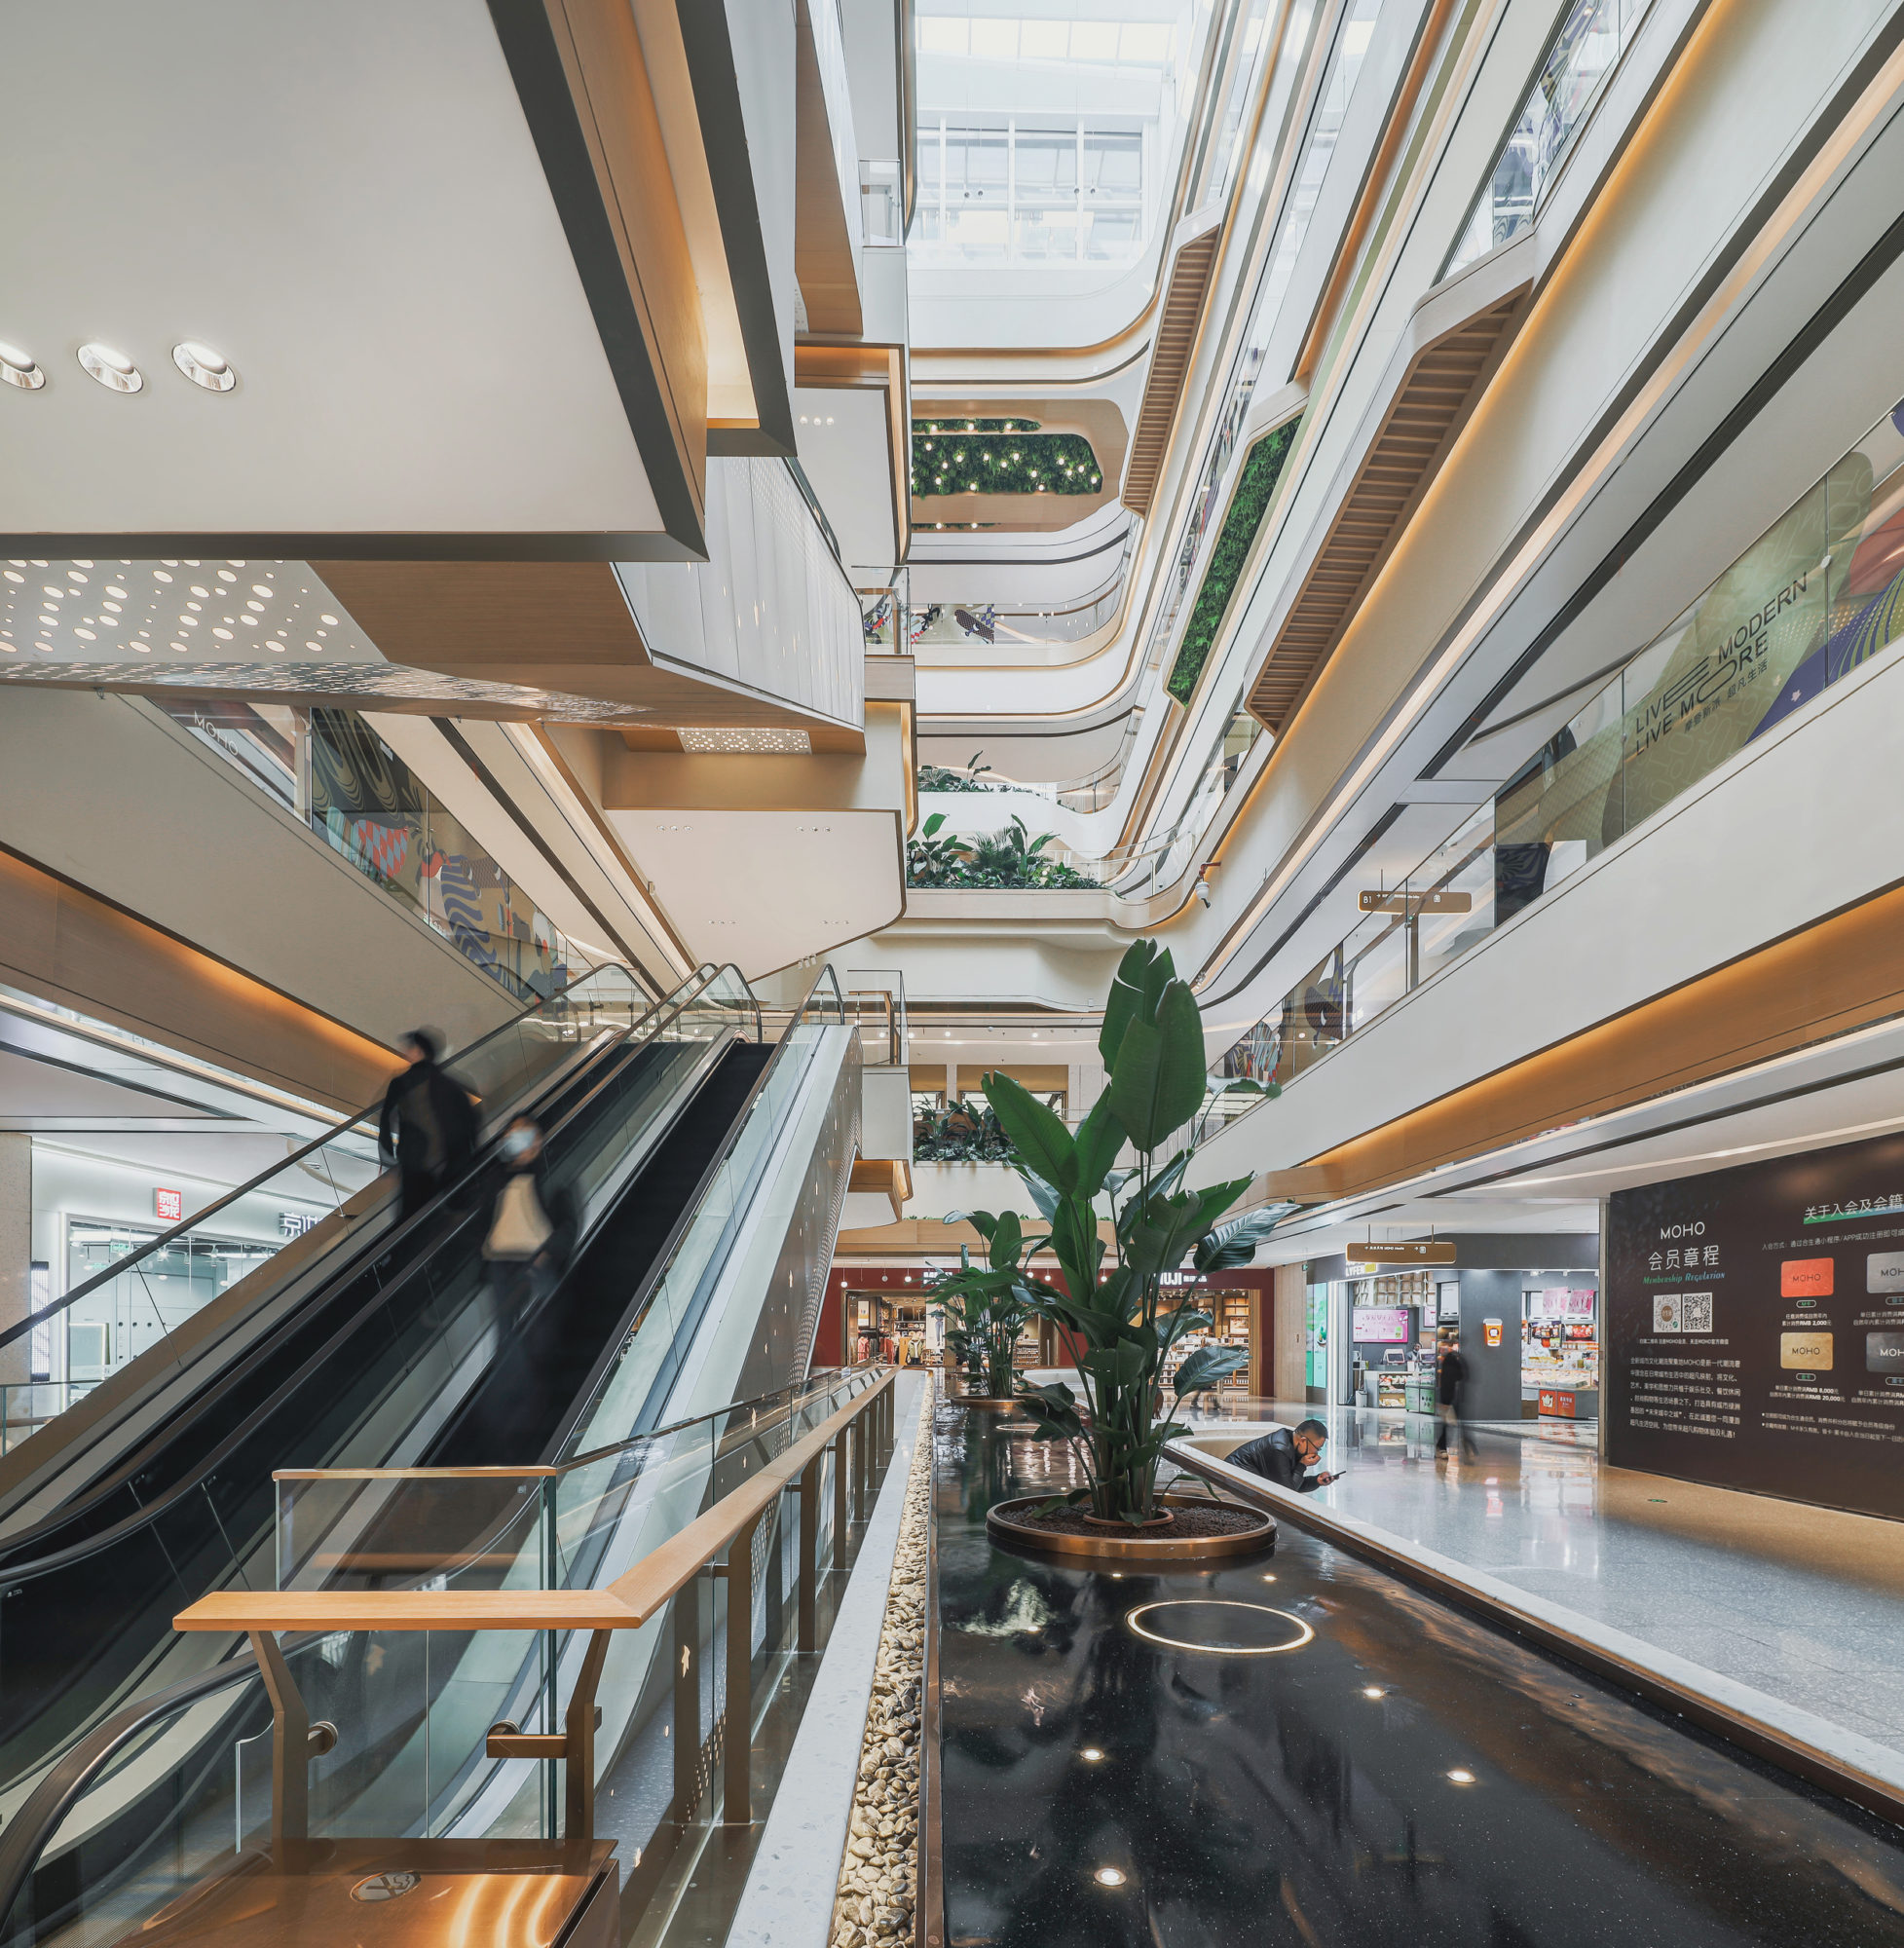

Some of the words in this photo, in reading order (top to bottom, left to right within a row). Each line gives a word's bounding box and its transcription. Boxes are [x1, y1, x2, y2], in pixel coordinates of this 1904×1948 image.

[1636, 656, 1710, 734] LIVE
[1717, 571, 1808, 665] MODERN
[1727, 657, 1768, 700] 超凡生活
[1636, 712, 1673, 756] LIVE
[1680, 630, 1769, 719] MORE
[194, 710, 239, 756] MOHO
[1363, 895, 1372, 904] B1
[1805, 1193, 1904, 1220] 关于入会及会籍
[1660, 1221, 1705, 1240] MOHO
[1648, 1244, 1720, 1271] 会员章程
[1643, 1273, 1683, 1285] Membership
[1792, 1273, 1821, 1283] MOHO
